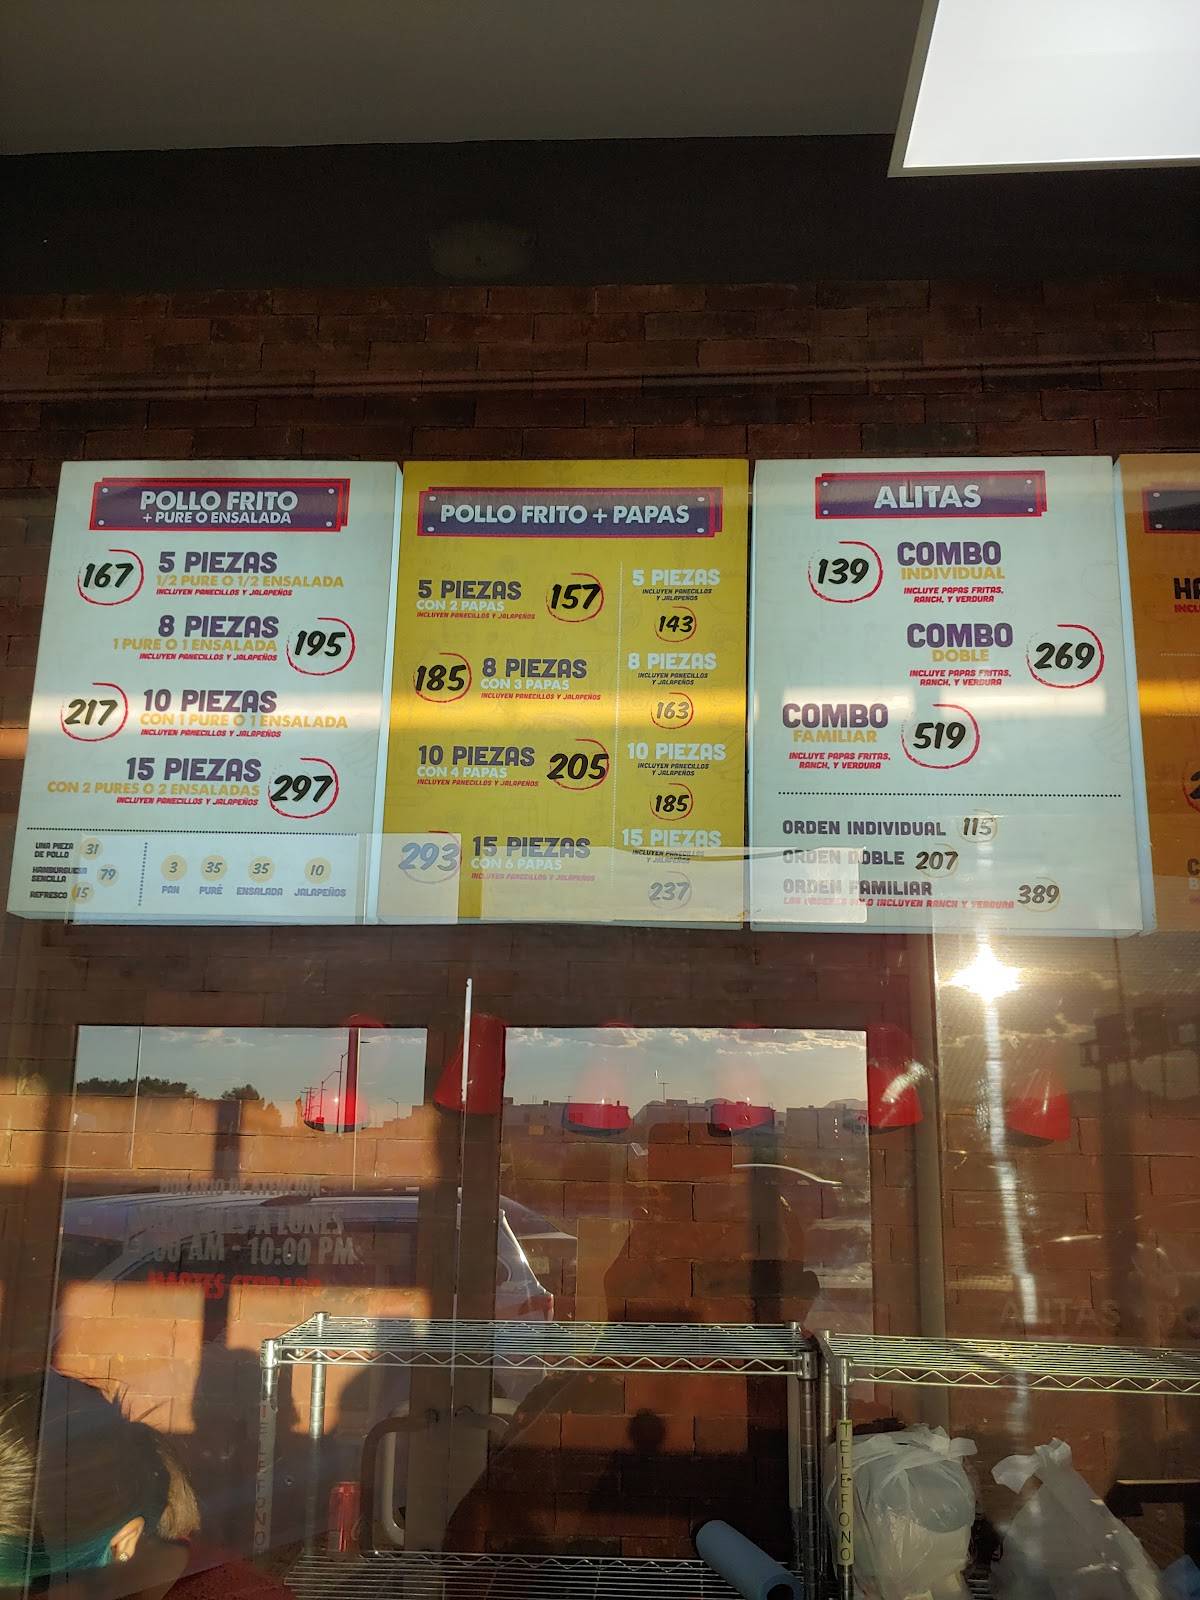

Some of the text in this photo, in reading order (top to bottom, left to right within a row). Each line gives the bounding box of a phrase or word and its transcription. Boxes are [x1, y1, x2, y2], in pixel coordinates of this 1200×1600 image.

[140, 491, 299, 510] POLLO FRITO
[874, 485, 982, 508] ALITAS
[143, 512, 291, 524] + PURE O ENSALADA
[441, 505, 690, 523] POLLO FRITO + PAPAS
[159, 552, 277, 573] 5 PIEZAS
[897, 541, 1001, 566] COMBO
[84, 563, 133, 588] 167
[632, 569, 721, 585] 5 PIEZAS
[818, 558, 870, 584] 139
[902, 567, 1004, 580] INDIVIDUAL
[157, 575, 344, 588] 1/2 PURE O 1/2 ENSALADA
[418, 580, 521, 599] 5 PIEZAS
[971, 586, 1004, 595] FRITAS,
[416, 600, 505, 611] CON 2 PAPAS
[551, 584, 600, 609] 157
[914, 595, 994, 604] RANCH, Y VERDURA
[159, 615, 279, 637] 8 PIEZAS
[659, 616, 693, 632] 143
[114, 638, 276, 651] 1 PURE O 1 ENSALADA
[295, 630, 346, 657] 195
[907, 623, 1013, 649] COMBO
[628, 653, 717, 669] 8 PIEZAS
[932, 649, 989, 663] DOBLE
[1034, 643, 1095, 670] 269
[483, 658, 587, 678] 8 PIEZAS
[415, 665, 466, 692] 185
[481, 678, 569, 690] CON 3 PAPAS
[143, 690, 277, 713] 10 PIEZAS
[656, 701, 689, 719] 163
[64, 699, 119, 725] 217
[140, 714, 348, 728] CON 1 PURE O 1 ENSALADA
[782, 704, 888, 729] COMBO
[793, 729, 877, 743] FAMILIAR
[913, 722, 966, 749] 519
[419, 746, 535, 766] 10 PIEZAS
[628, 743, 727, 760] 10 PIEZAS
[789, 752, 891, 761] INCLUYE PAPAS FRITAS,
[127, 757, 261, 781] 15 PIEZAS
[417, 766, 507, 778] CON 4 PAPAS
[547, 754, 609, 780] 205
[799, 761, 881, 770] RANCH, Y VERDURA
[47, 781, 259, 796] CON 2 PURES O 2 ENSALADAS
[270, 776, 333, 802] 297
[655, 795, 689, 812] 185
[783, 820, 946, 836] ORDEN INDIVIDUAL
[962, 817, 993, 836] 115
[622, 829, 721, 847] 15 PIEZAS
[86, 844, 98, 855] 31
[398, 842, 459, 871] 293
[473, 837, 590, 858] 15 PIEZAS
[471, 858, 562, 870] CON 6 PAPAS
[783, 849, 905, 865] ORDEN DOBLE
[915, 851, 958, 870] 207
[101, 868, 116, 881] 79
[168, 862, 324, 876] 3 35 35 10
[75, 887, 88, 898] 15
[162, 886, 179, 895] PAN
[236, 887, 283, 896] ENSALADA
[294, 886, 346, 897] JALAPEÑOS
[650, 882, 688, 900] 237
[783, 879, 932, 896] ORDEN FAMILIAR
[1018, 885, 1060, 904] 389
[319, 1237, 355, 1265] PM
[838, 1422, 850, 1561] TELEFONO
